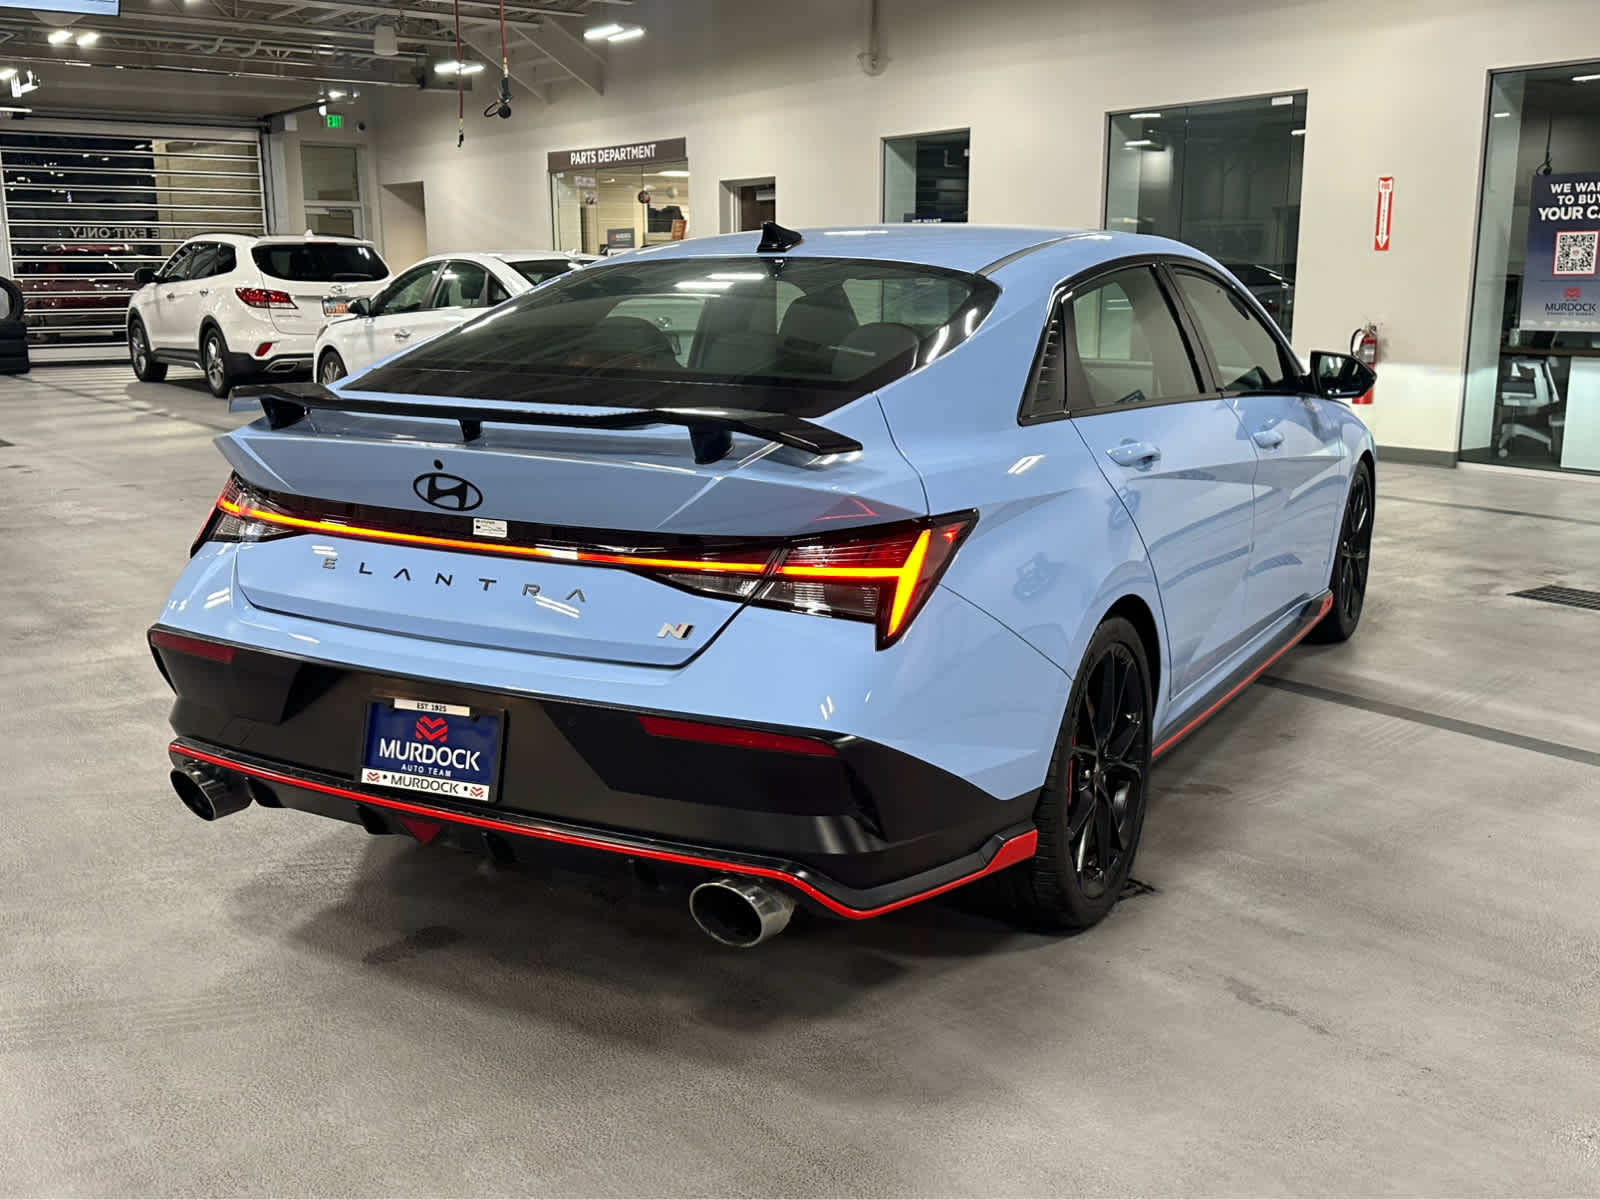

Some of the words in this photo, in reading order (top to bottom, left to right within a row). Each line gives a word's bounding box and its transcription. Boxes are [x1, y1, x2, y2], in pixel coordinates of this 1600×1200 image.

[327, 114, 342, 128] EXIT
[570, 151, 596, 165] PARTS
[598, 144, 656, 163] DEPARTMENT
[1550, 183, 1572, 193] WE
[1557, 194, 1575, 205] TO
[1538, 205, 1584, 221] YOUR
[1544, 302, 1598, 312] MURDOCK
[322, 557, 586, 602] ELANTRA
[416, 702, 429, 710] EST
[379, 738, 480, 771] MURDOCK
[401, 763, 424, 774] AUTO
[428, 767, 452, 777] TEAM
[390, 774, 460, 794] MURDOCK
